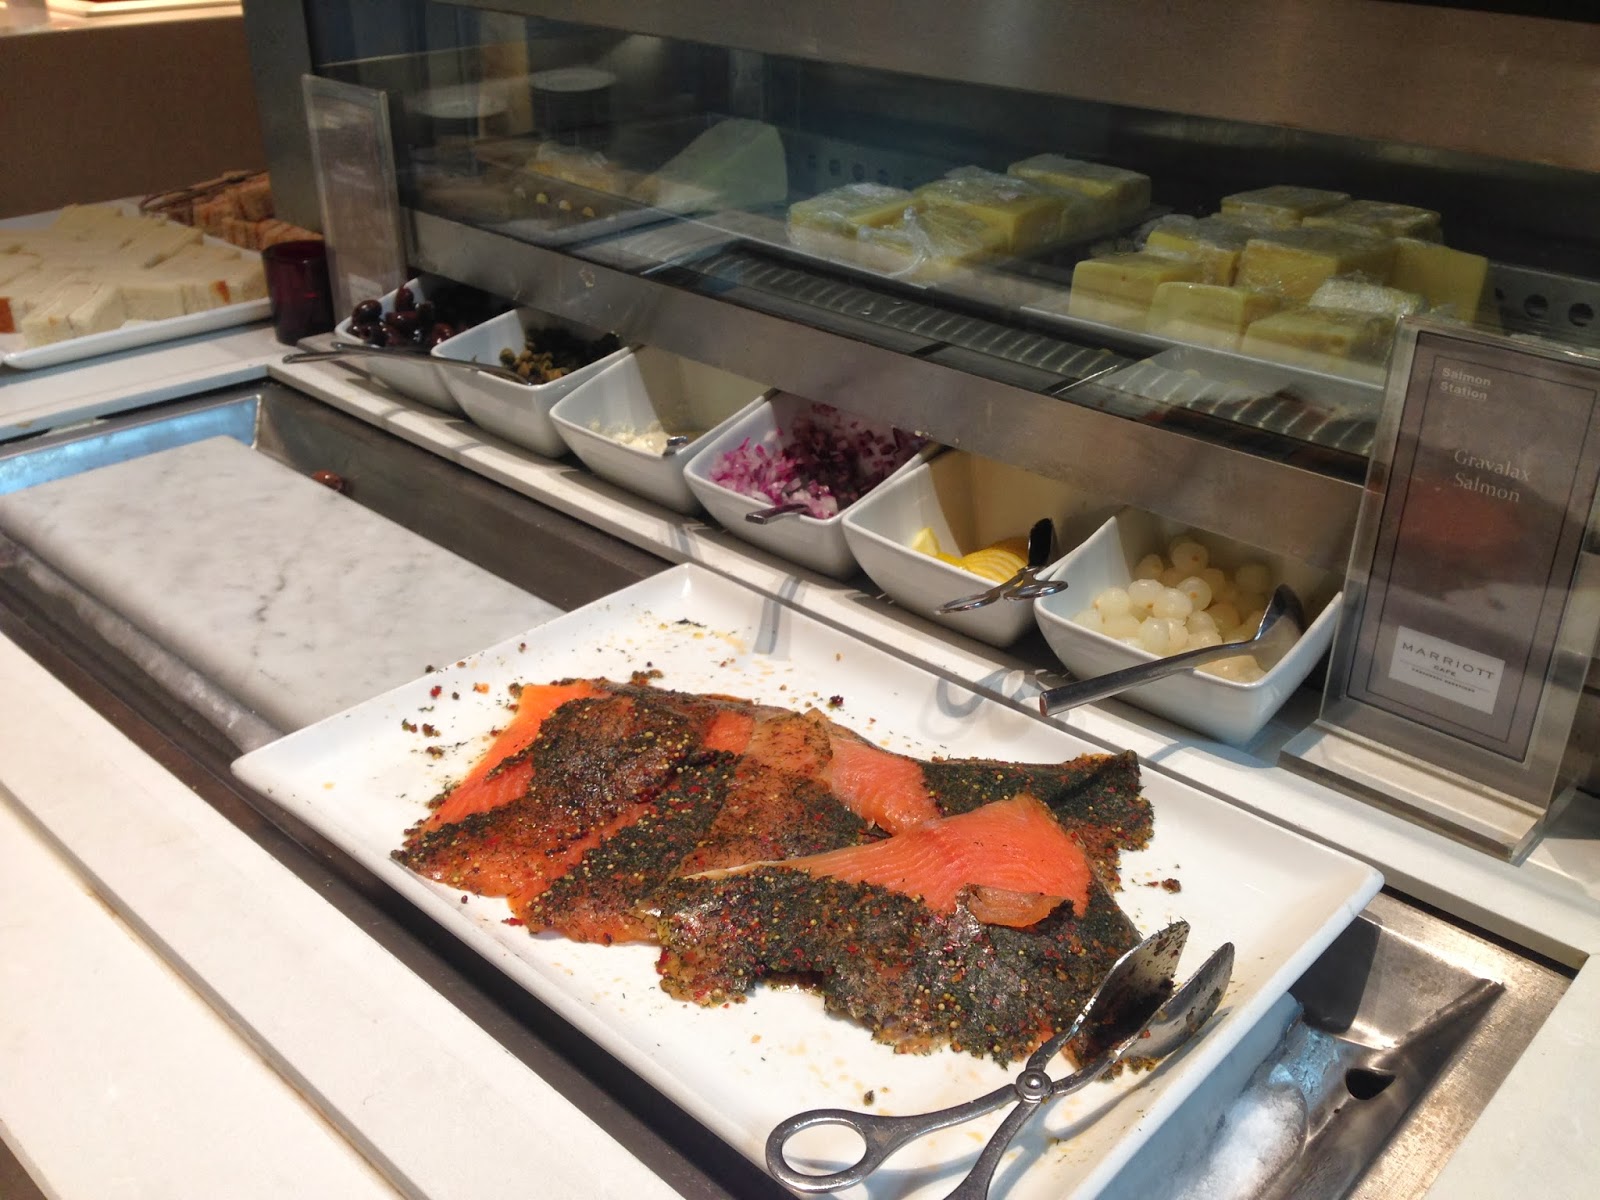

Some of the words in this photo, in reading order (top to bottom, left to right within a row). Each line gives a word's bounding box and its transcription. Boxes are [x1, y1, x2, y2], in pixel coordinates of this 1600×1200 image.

[1440, 382, 1487, 400] Station
[1442, 368, 1491, 386] Salmon
[1454, 449, 1530, 482] Gravalax
[1455, 472, 1520, 503] Salmon
[1402, 642, 1495, 680] MARRIOTT
